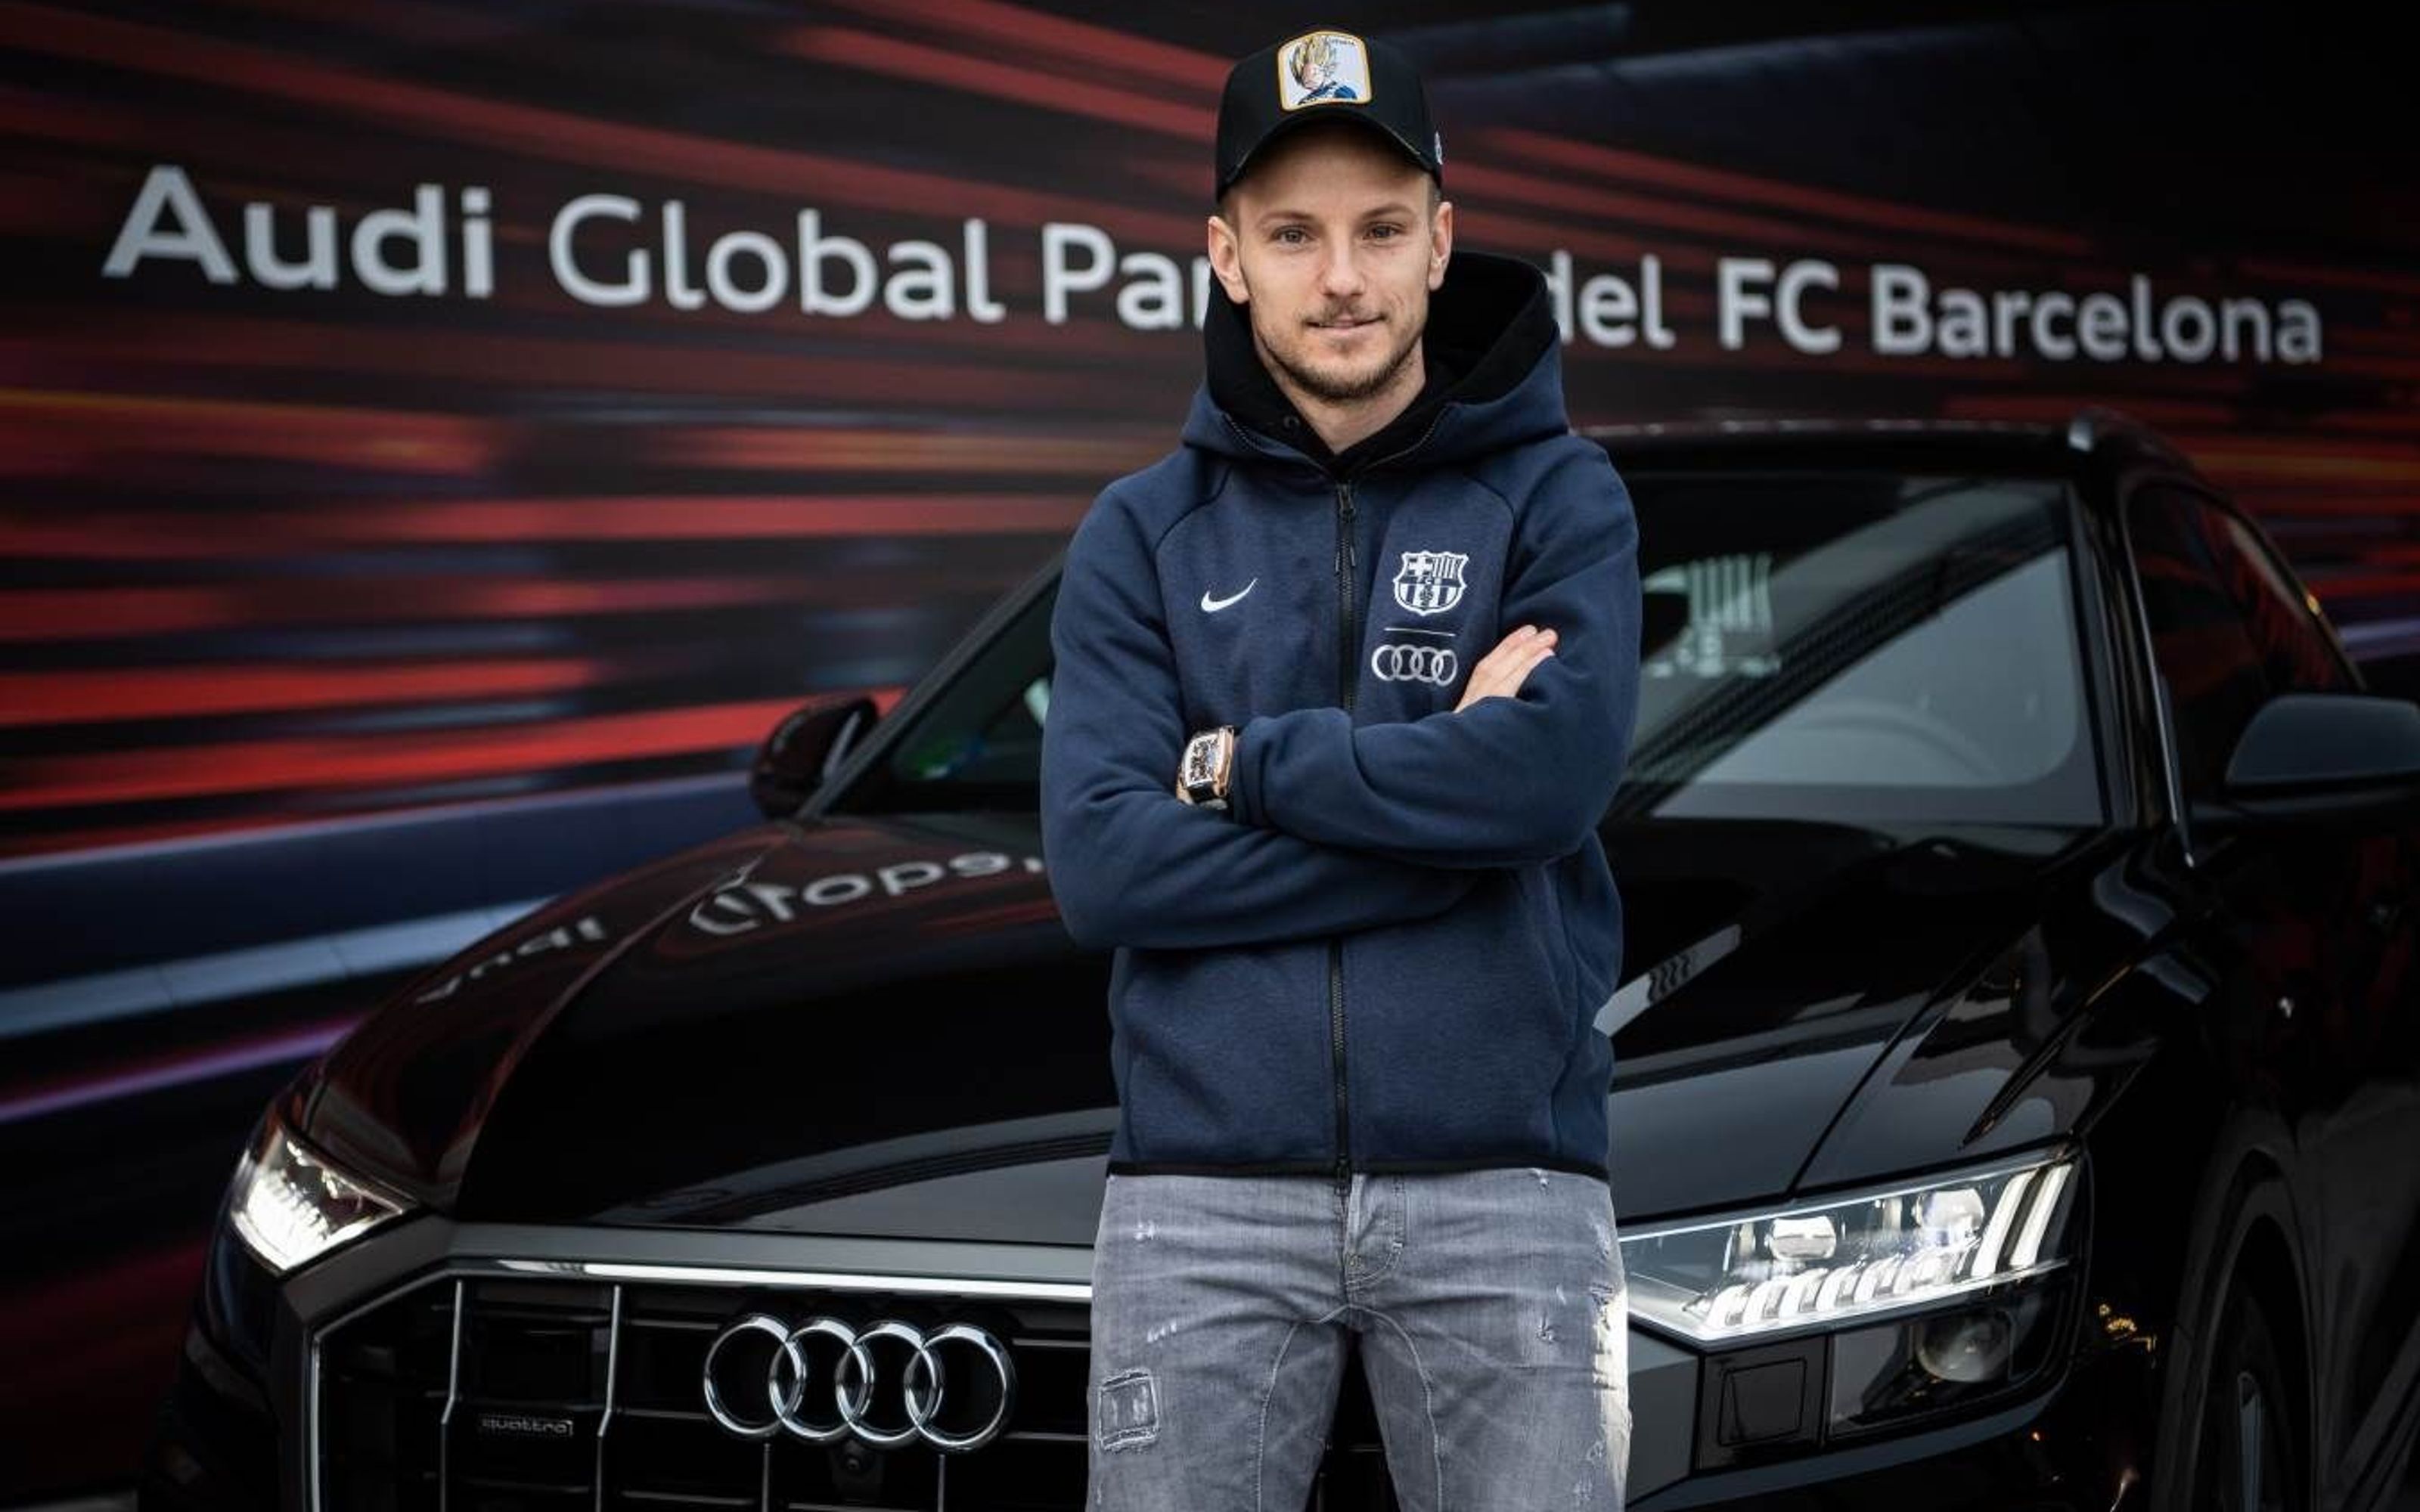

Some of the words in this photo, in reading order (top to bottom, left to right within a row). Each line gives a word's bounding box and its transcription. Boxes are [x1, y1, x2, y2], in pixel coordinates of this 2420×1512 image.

[102, 165, 495, 299] Audi
[548, 193, 1007, 325] Global
[1717, 257, 1841, 354] FC
[1871, 265, 2320, 361] Barcelona
